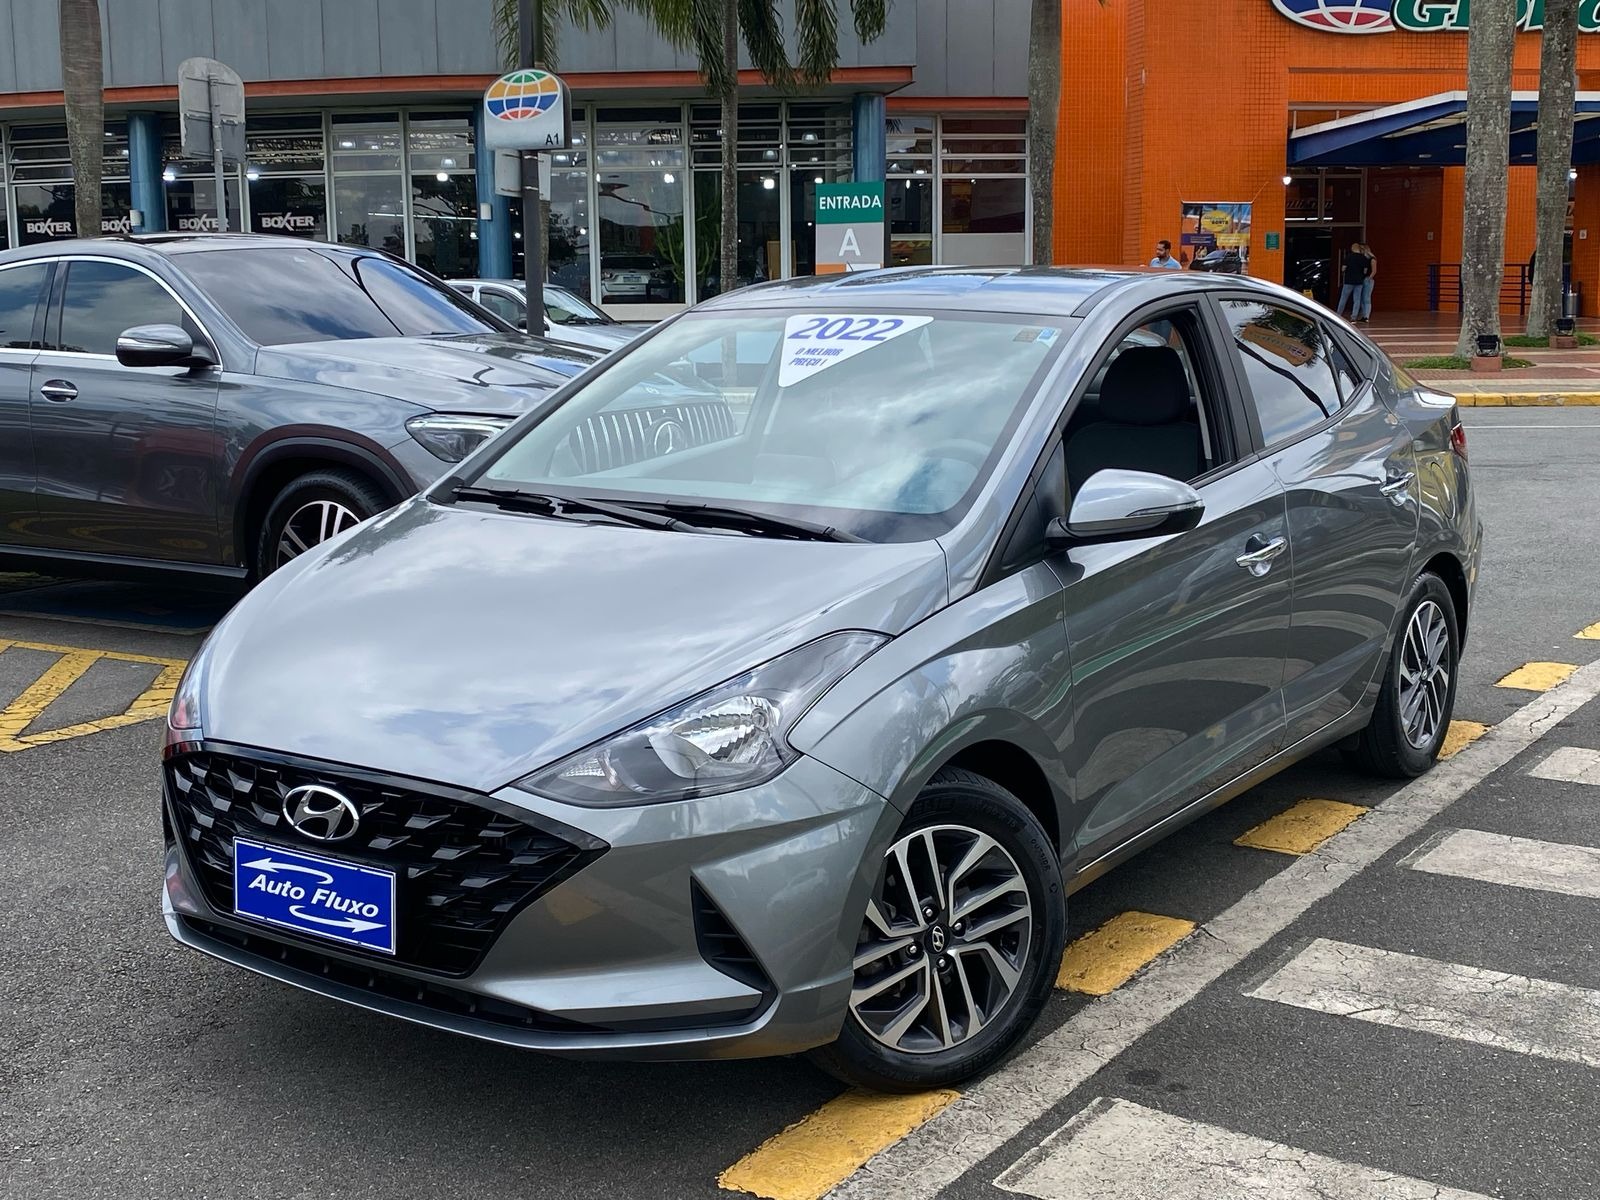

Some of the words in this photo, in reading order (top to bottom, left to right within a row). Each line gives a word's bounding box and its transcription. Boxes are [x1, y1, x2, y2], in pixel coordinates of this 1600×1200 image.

[545, 133, 559, 145] A1
[819, 194, 882, 210] ENTRADA
[26, 217, 72, 236] BOXTER
[101, 216, 132, 234] BOXT
[262, 212, 315, 232] BOXTER
[838, 228, 862, 257] A
[787, 317, 905, 342] 2022
[803, 348, 844, 356] MELHOR
[248, 873, 306, 900] Auto
[310, 888, 379, 918] Fluxo
